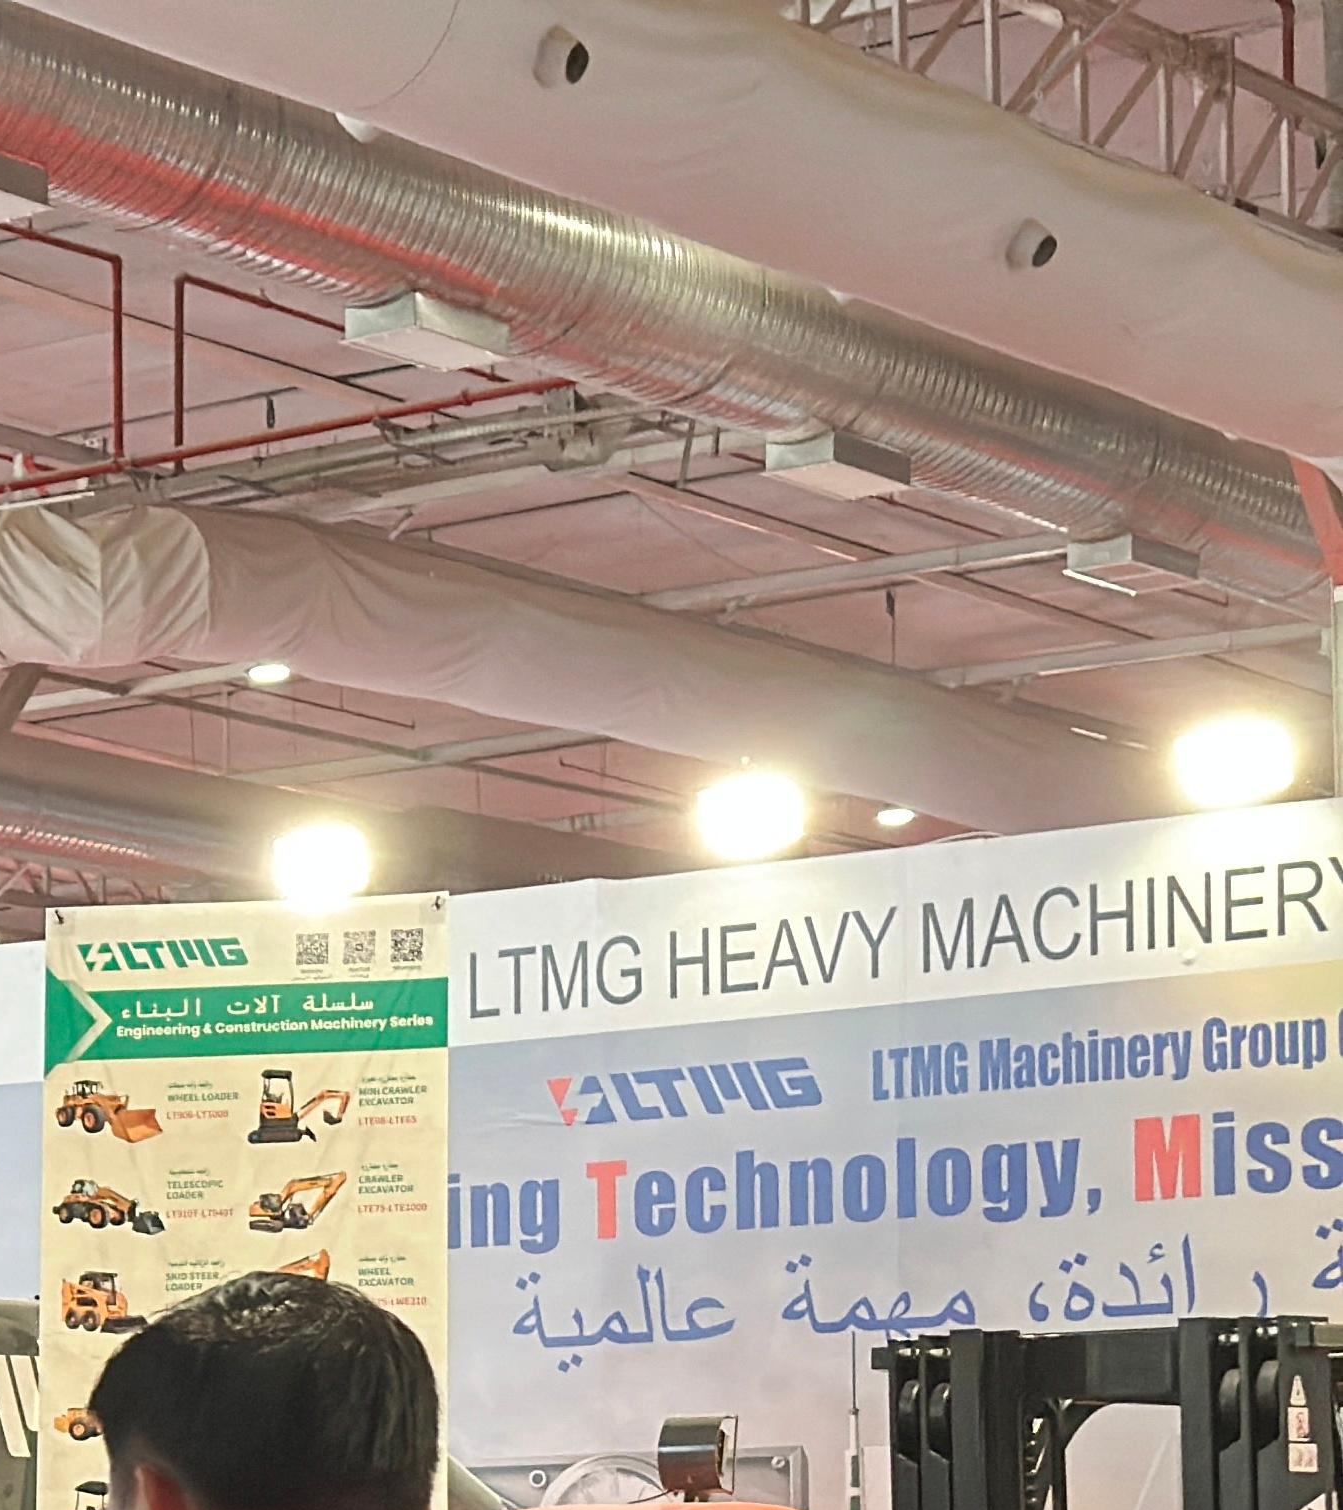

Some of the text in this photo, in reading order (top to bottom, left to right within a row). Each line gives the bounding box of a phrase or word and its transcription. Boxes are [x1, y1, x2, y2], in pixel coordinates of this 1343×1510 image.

[117, 937, 248, 970] LTMG
[469, 932, 643, 1019] LTMG
[669, 906, 897, 999] HEAVY
[302, 992, 374, 1013] سلسلة
[121, 998, 202, 1021] البناء
[116, 1014, 434, 1039] Engineering & Construction Machinery Series
[872, 1043, 968, 1101] LTMG
[979, 1029, 1191, 1091] Machinery
[1202, 1017, 1326, 1072] Group
[201, 1092, 239, 1101] LOADER
[359, 1096, 414, 1107] EXCAVATOR
[358, 1174, 404, 1184] CRAWLER
[358, 1185, 414, 1194] EXCAVATOR
[166, 1191, 203, 1200] LOADER
[447, 1173, 559, 1255] ing
[585, 1137, 1103, 1241] Technology,
[189, 1272, 220, 1281] STEER
[358, 1267, 391, 1276] WHEEL
[165, 1283, 203, 1292] LOADER
[358, 1277, 415, 1287] EXCAVATOR
[513, 1265, 736, 1374] عالمية
